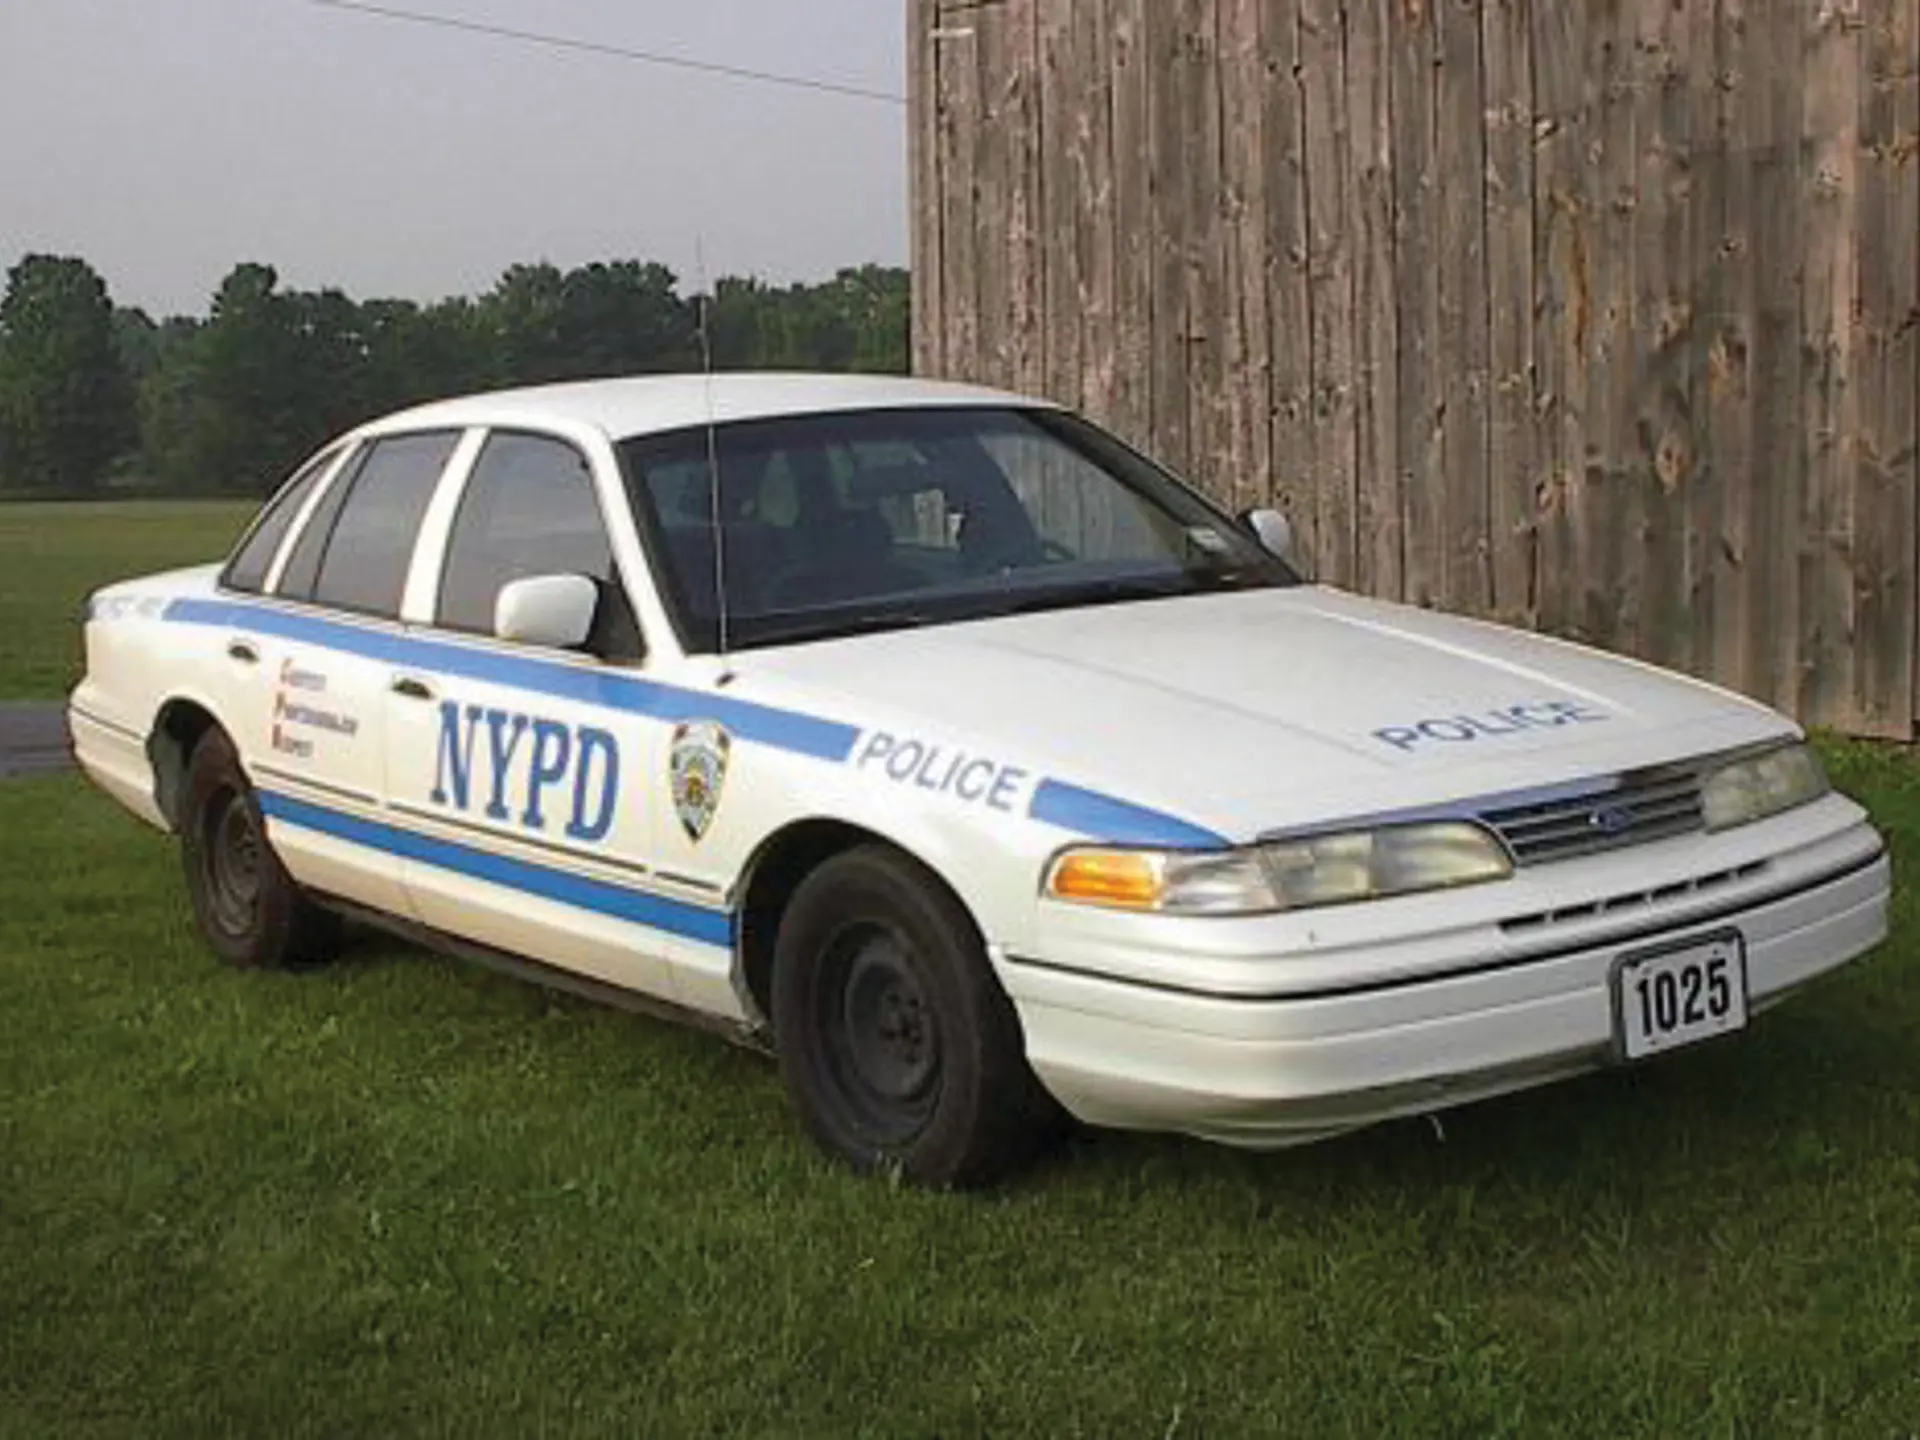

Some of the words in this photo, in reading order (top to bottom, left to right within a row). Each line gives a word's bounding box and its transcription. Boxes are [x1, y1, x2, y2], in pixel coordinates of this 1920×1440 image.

[1373, 702, 1610, 751] POLICE
[430, 702, 619, 841] NYPD
[857, 731, 1028, 811] POLICE
[1635, 957, 1730, 1037] 1025
